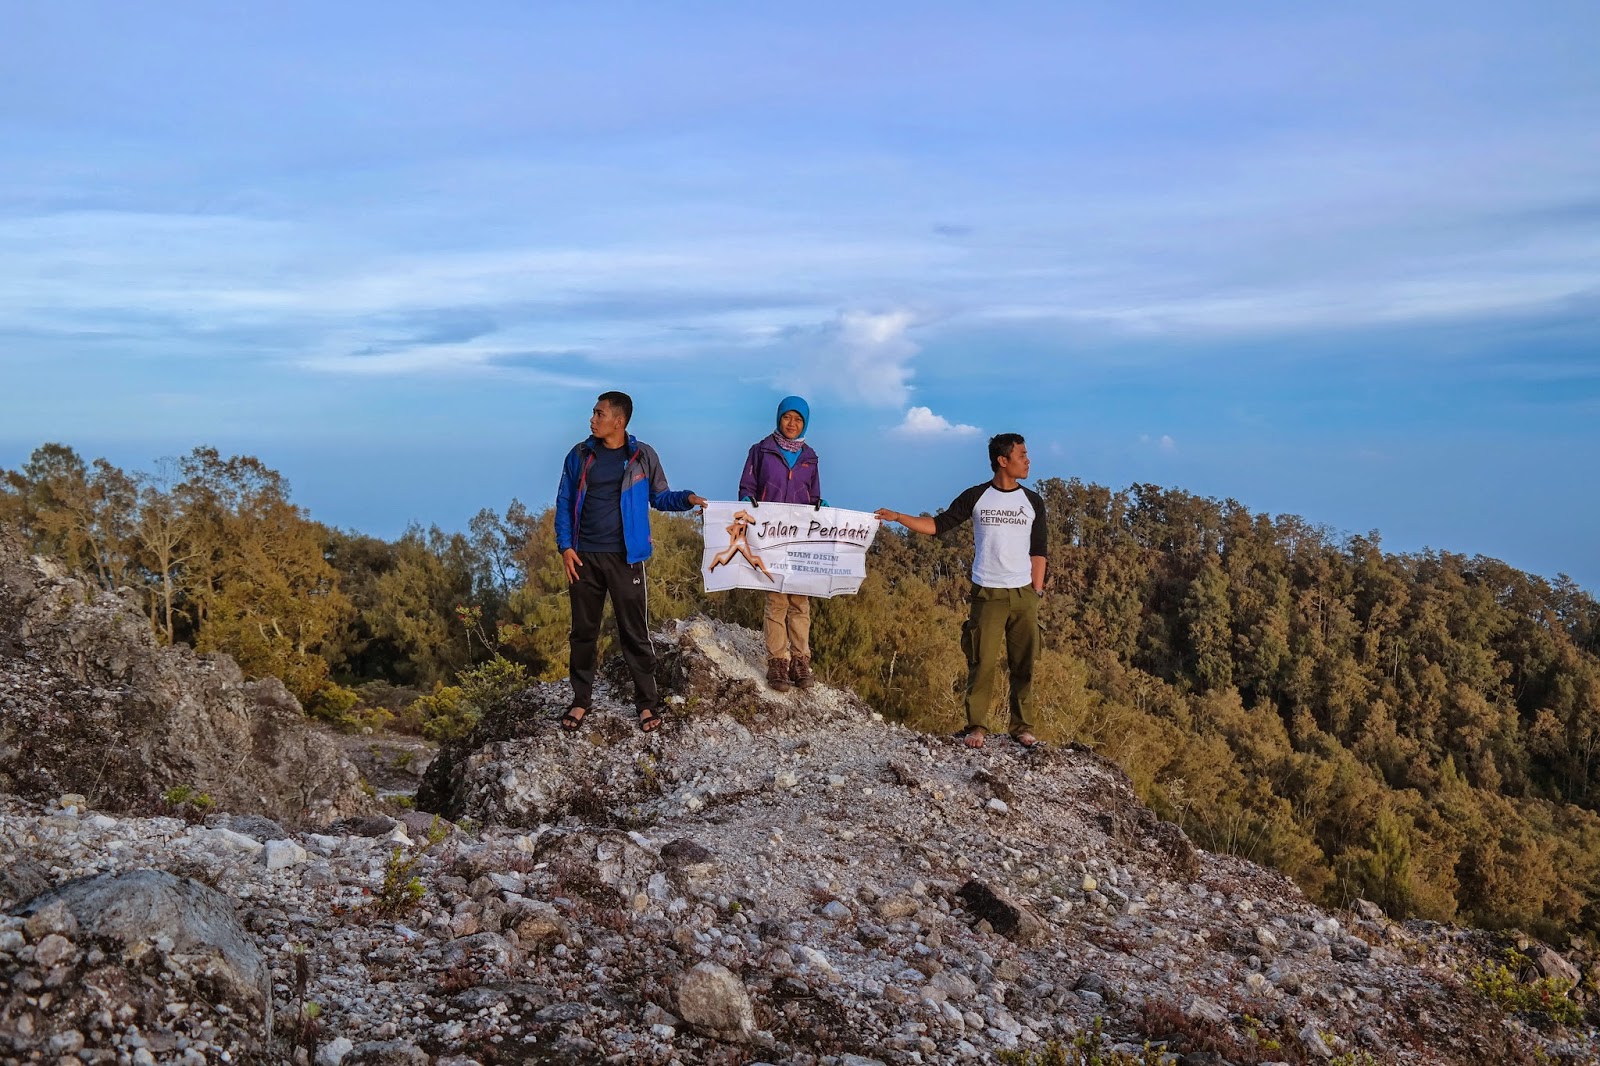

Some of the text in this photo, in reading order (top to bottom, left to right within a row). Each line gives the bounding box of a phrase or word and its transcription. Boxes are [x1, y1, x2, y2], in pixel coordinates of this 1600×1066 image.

[980, 509, 1017, 517] PECANDU
[980, 517, 1027, 525] KETINGGIAN
[757, 520, 871, 540] Jalan Pendaki
[788, 551, 839, 561] DIAM DISINI
